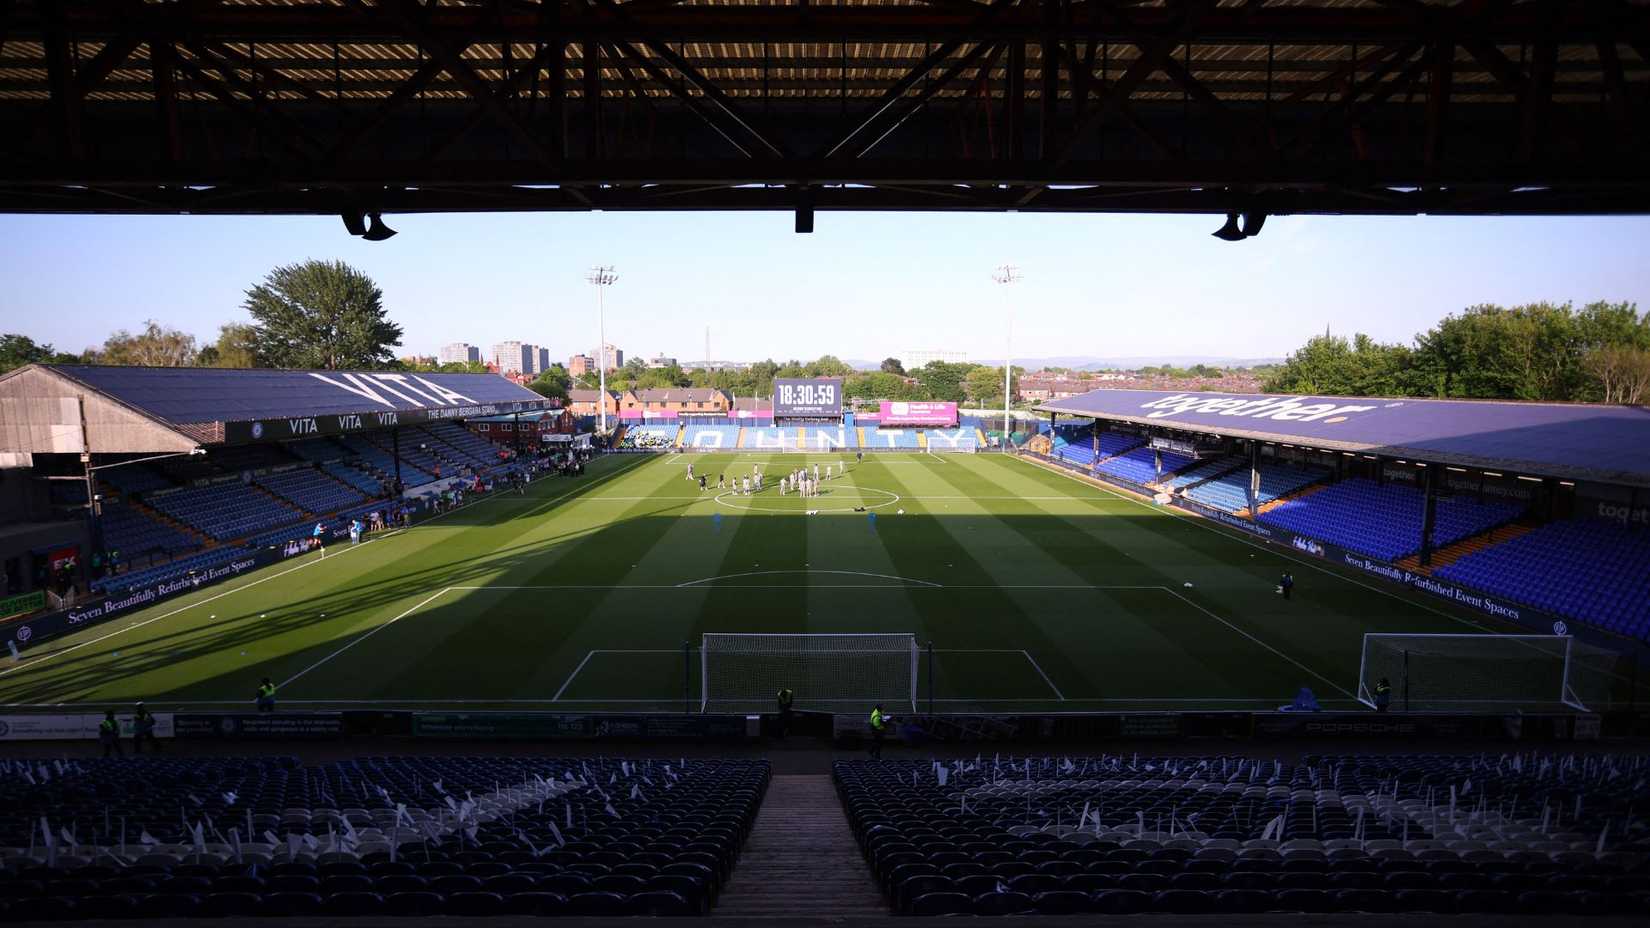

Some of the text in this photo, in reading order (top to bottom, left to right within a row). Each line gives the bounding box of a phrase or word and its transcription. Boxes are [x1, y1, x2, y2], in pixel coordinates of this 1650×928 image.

[307, 373, 478, 407] VITA
[778, 384, 834, 405] 18:30:59
[289, 412, 398, 433] VITA VITA VITA
[428, 409, 439, 419] THE
[440, 408, 458, 418] DANNY
[67, 607, 103, 624] Seven
[104, 588, 156, 614] Beautifully
[208, 566, 231, 580] Event
[231, 558, 256, 573] Spaces
[1344, 553, 1520, 620] Seven Beautifully Refurbished Event Spaces
